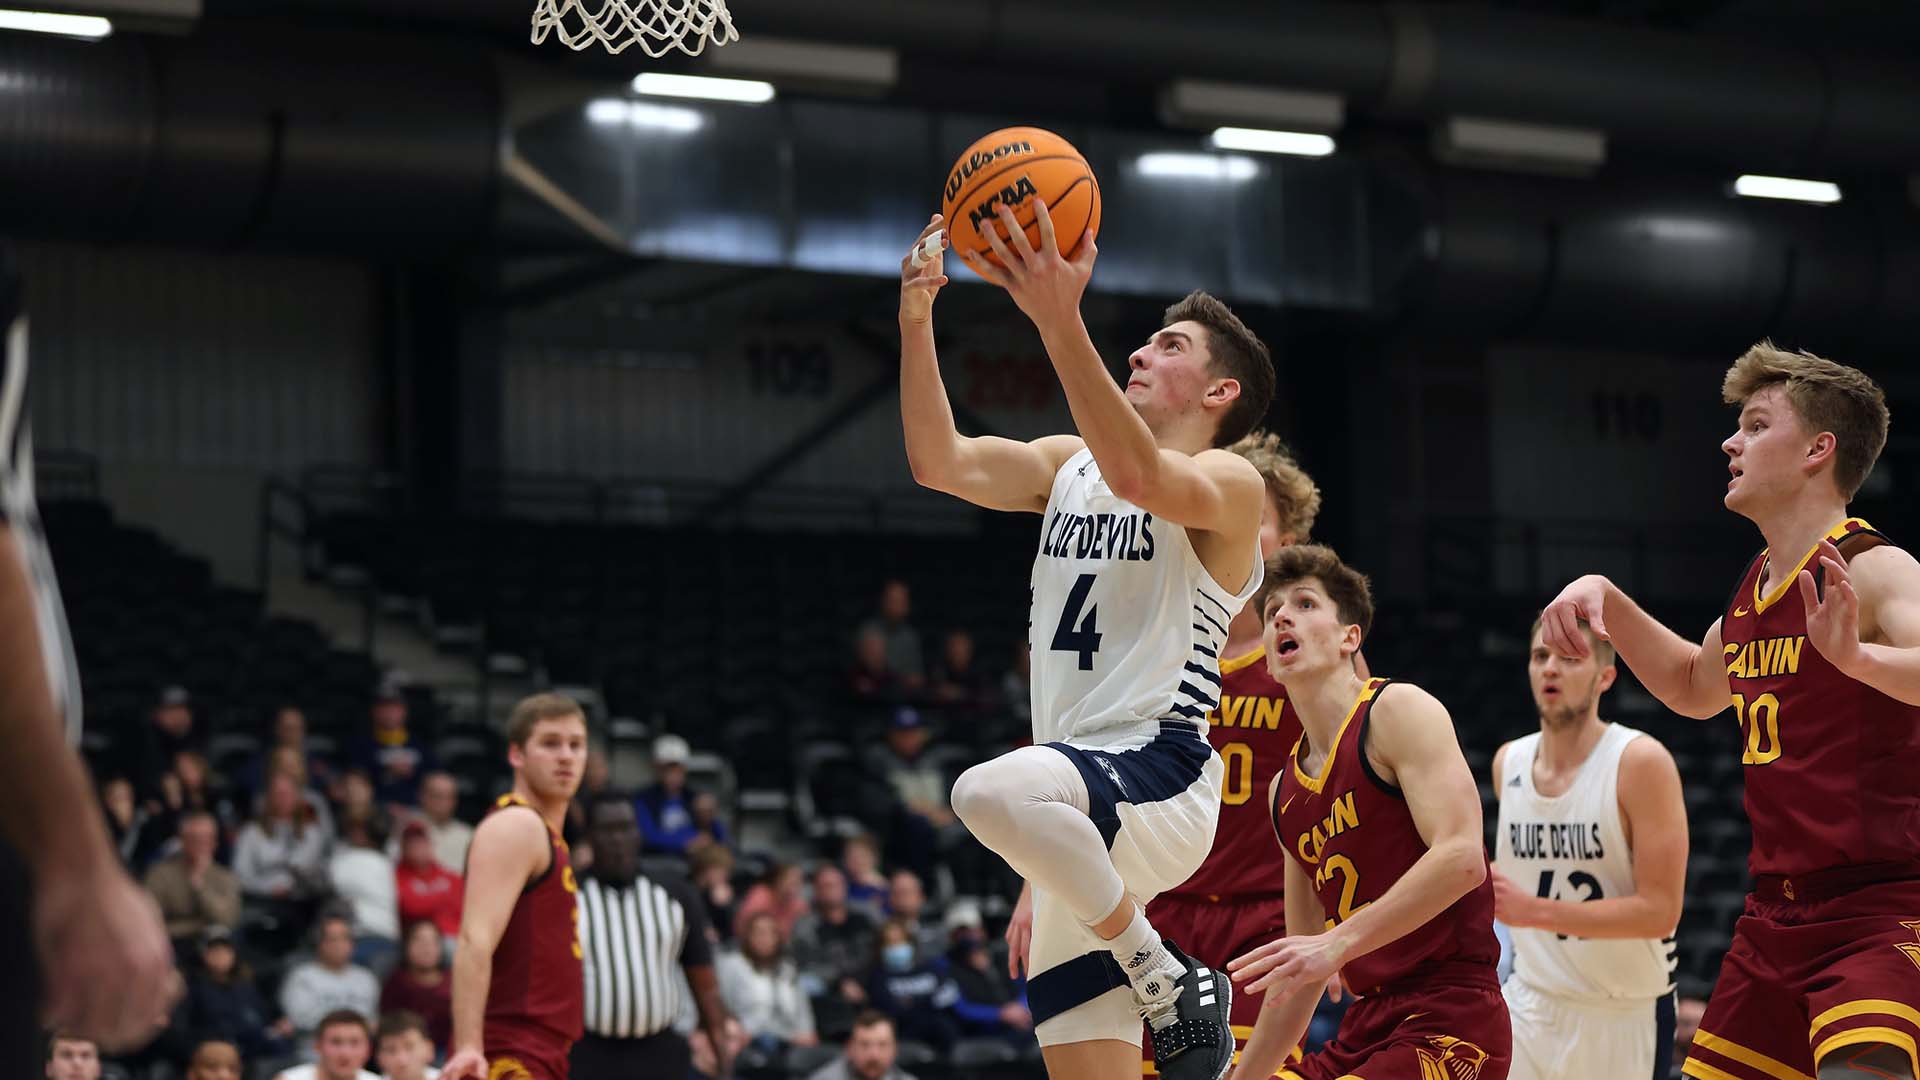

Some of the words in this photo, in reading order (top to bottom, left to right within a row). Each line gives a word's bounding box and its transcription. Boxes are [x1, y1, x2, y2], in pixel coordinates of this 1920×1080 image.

[945, 141, 1034, 202] Wilson
[968, 175, 1037, 233] NCAA
[1043, 508, 1085, 558] LUE
[1075, 512, 1155, 562] DEVILS
[1050, 573, 1102, 671] 4
[1206, 695, 1285, 730] LVIN
[1219, 742, 1254, 805] 0
[1510, 823, 1548, 859] BLUE
[1549, 822, 1604, 861] DEVILS
